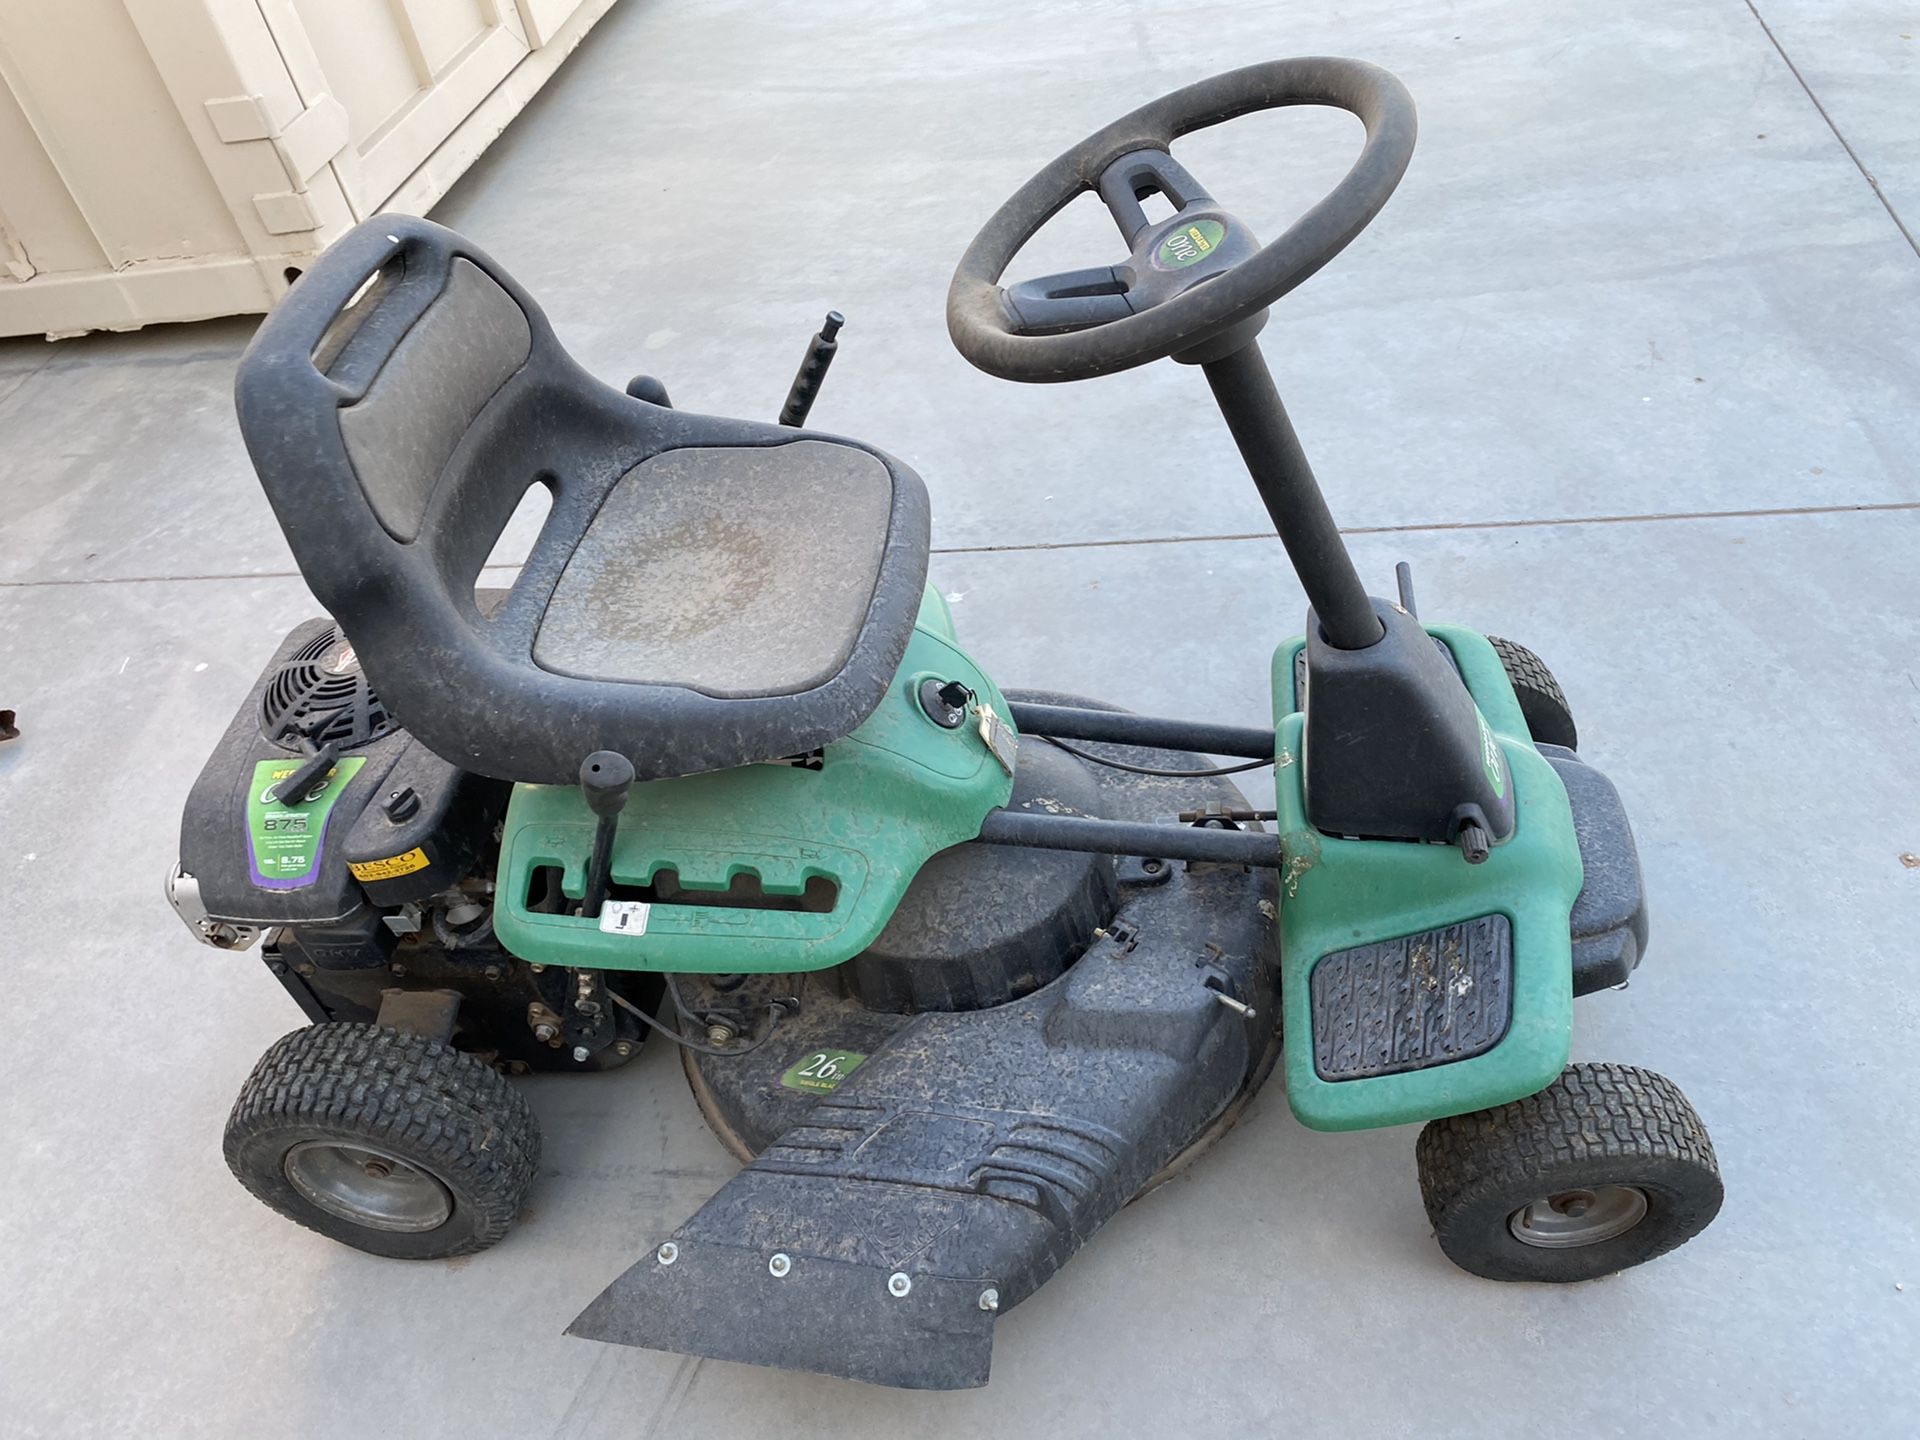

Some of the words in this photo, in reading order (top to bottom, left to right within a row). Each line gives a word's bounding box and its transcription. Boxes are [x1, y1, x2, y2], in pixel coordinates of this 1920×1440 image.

[260, 781, 329, 804] Oe
[264, 819, 308, 831] 875
[280, 856, 306, 865] 8.75
[797, 1053, 846, 1079] 26
